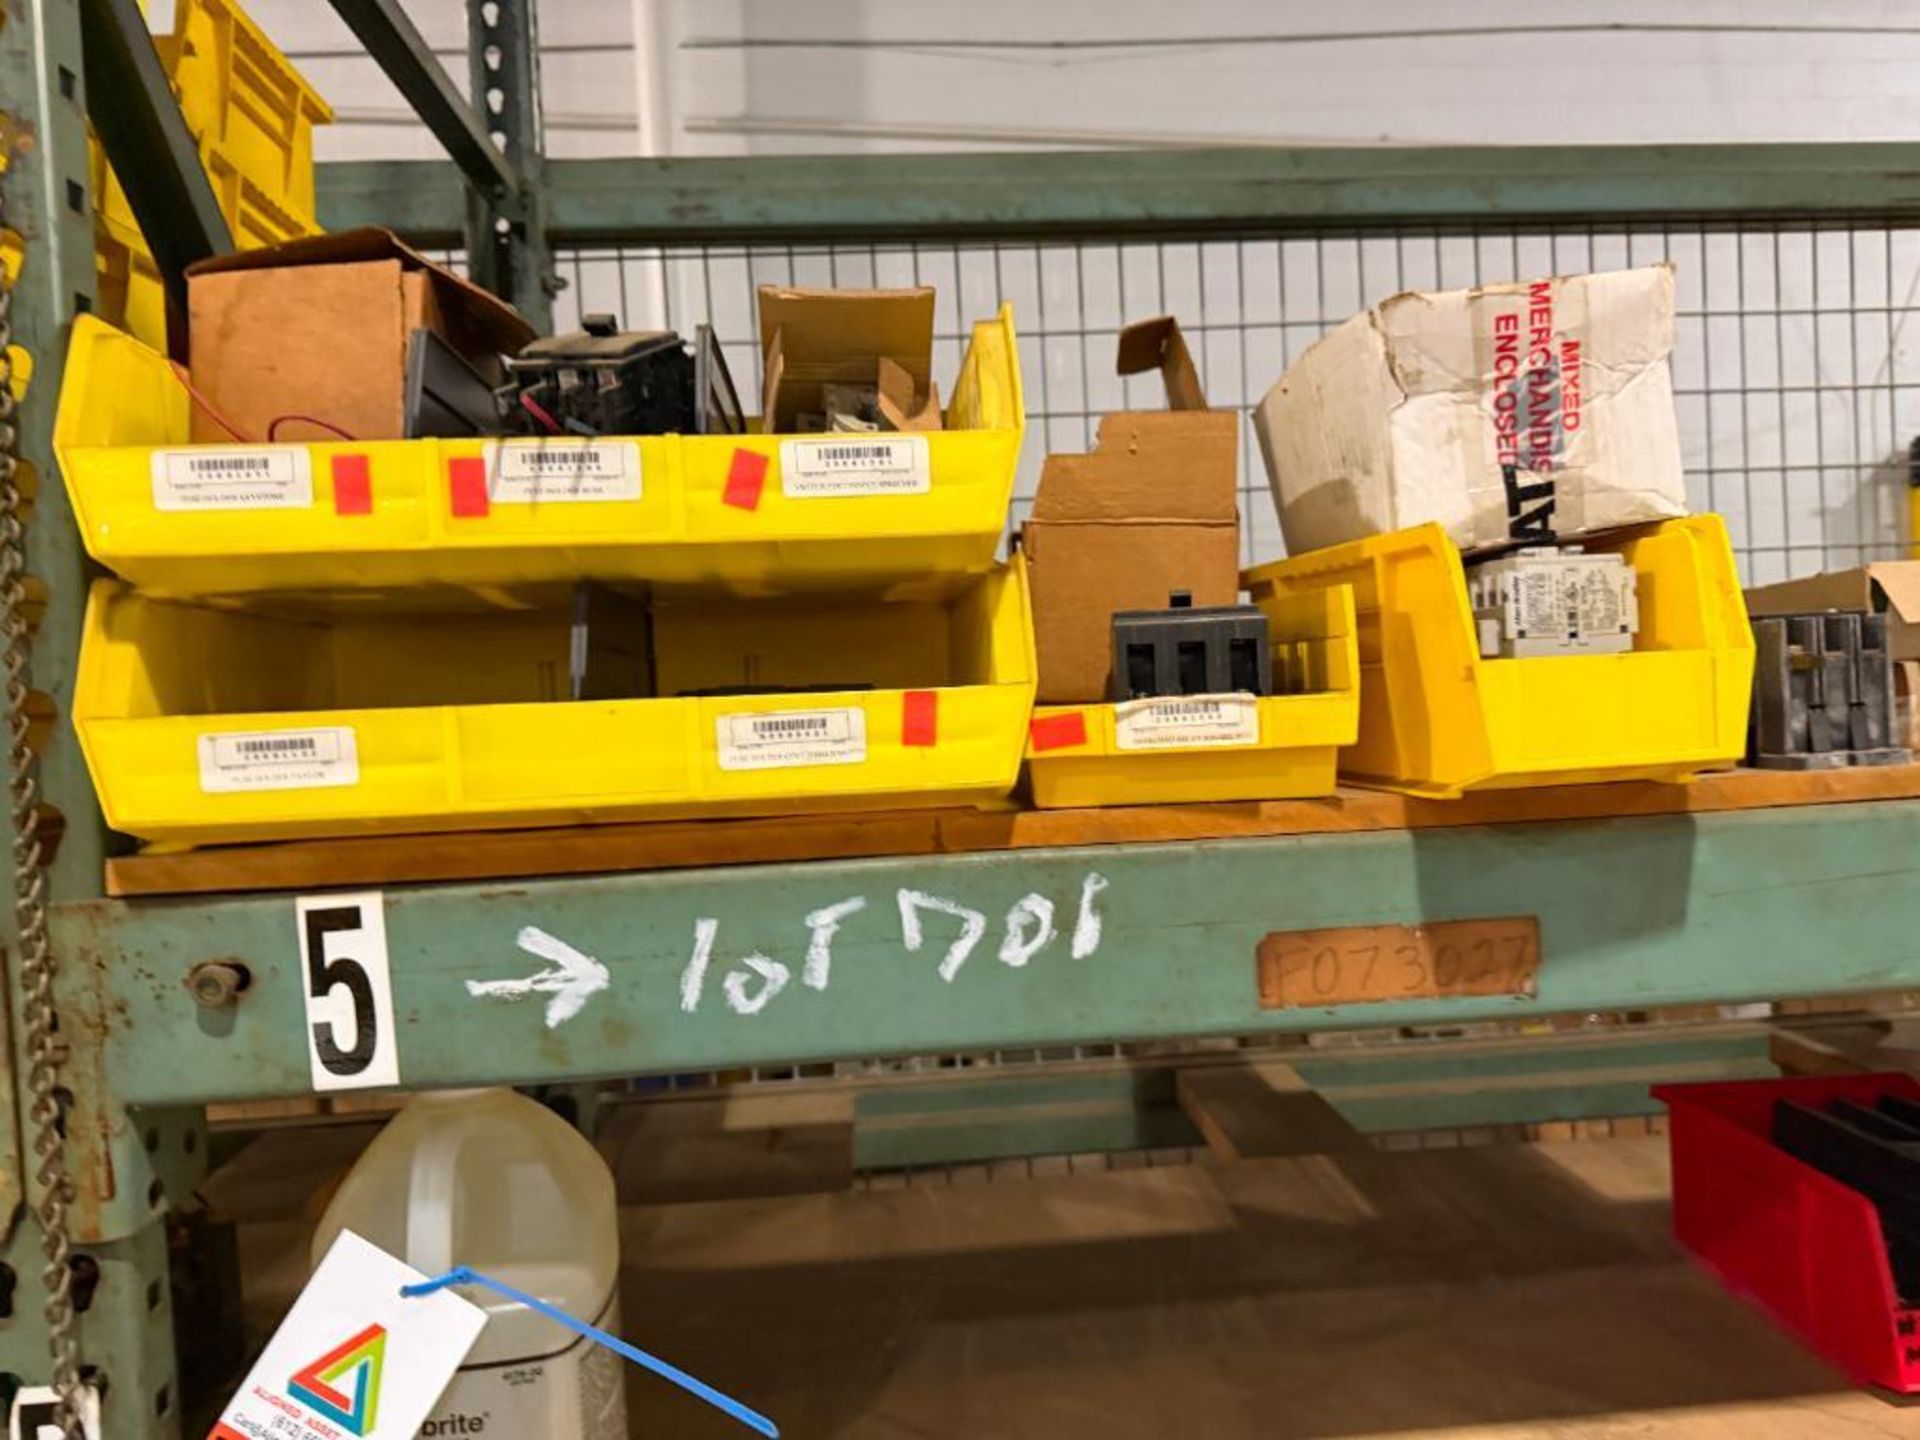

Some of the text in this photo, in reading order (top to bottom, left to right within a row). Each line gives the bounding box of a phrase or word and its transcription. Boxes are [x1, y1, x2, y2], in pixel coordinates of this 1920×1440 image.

[1528, 282, 1552, 472] MERCHANDIS
[1561, 341, 1580, 431] MIXED
[304, 905, 377, 1076] 5
